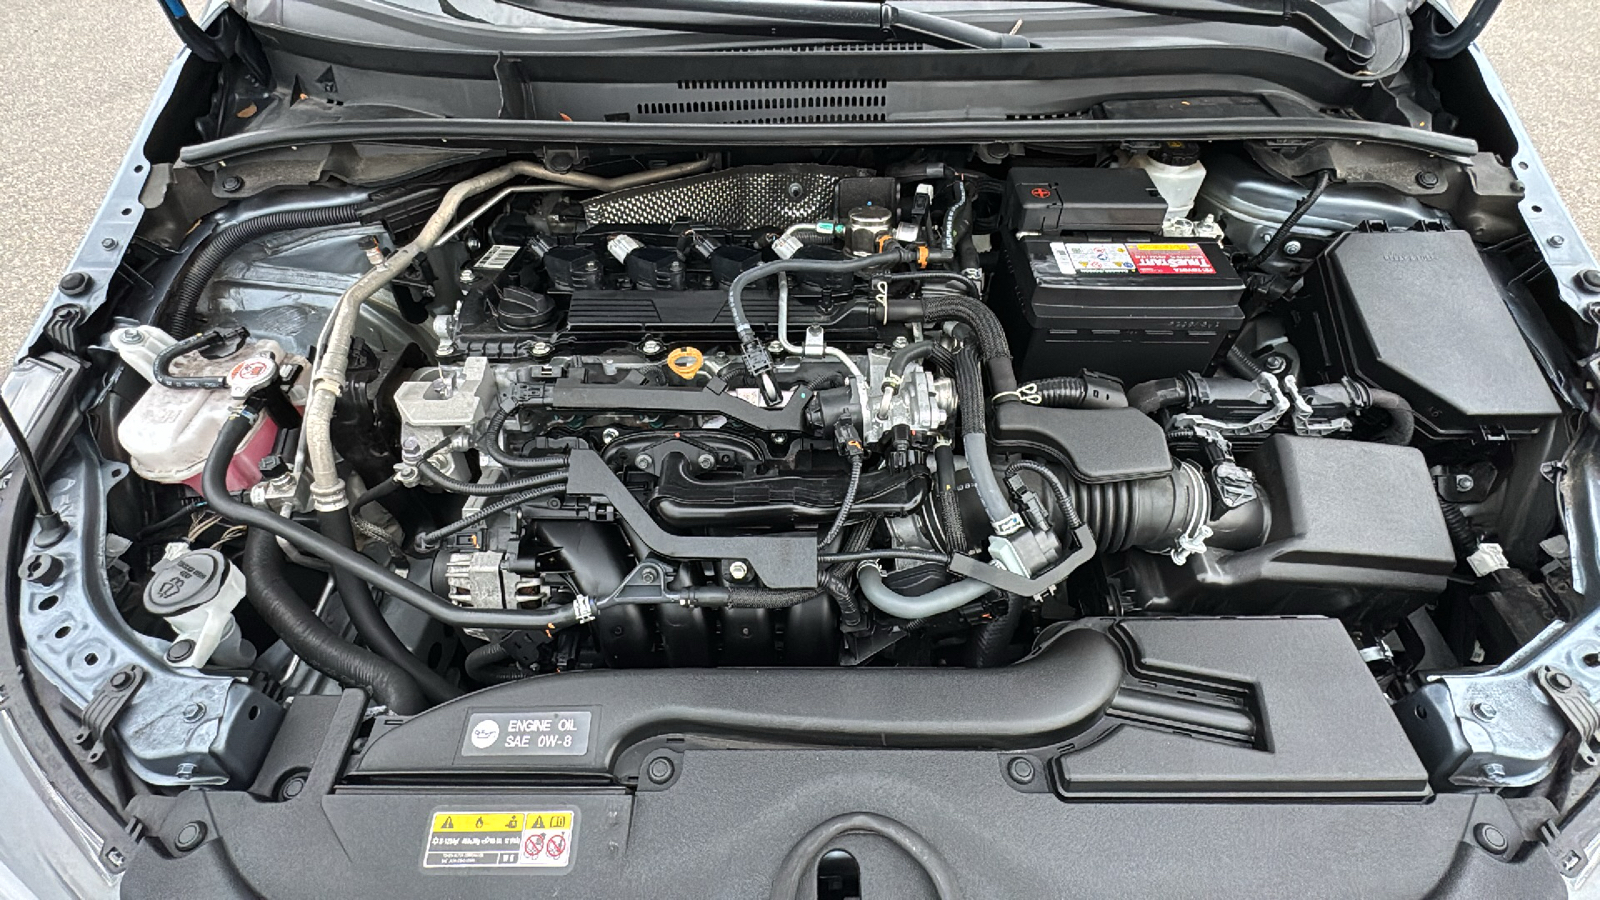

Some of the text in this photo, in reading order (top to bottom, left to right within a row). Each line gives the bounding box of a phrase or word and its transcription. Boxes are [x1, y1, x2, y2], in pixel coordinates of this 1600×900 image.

[508, 718, 577, 732] ENGINE OIL
[504, 734, 573, 748] SAE 0W-8
